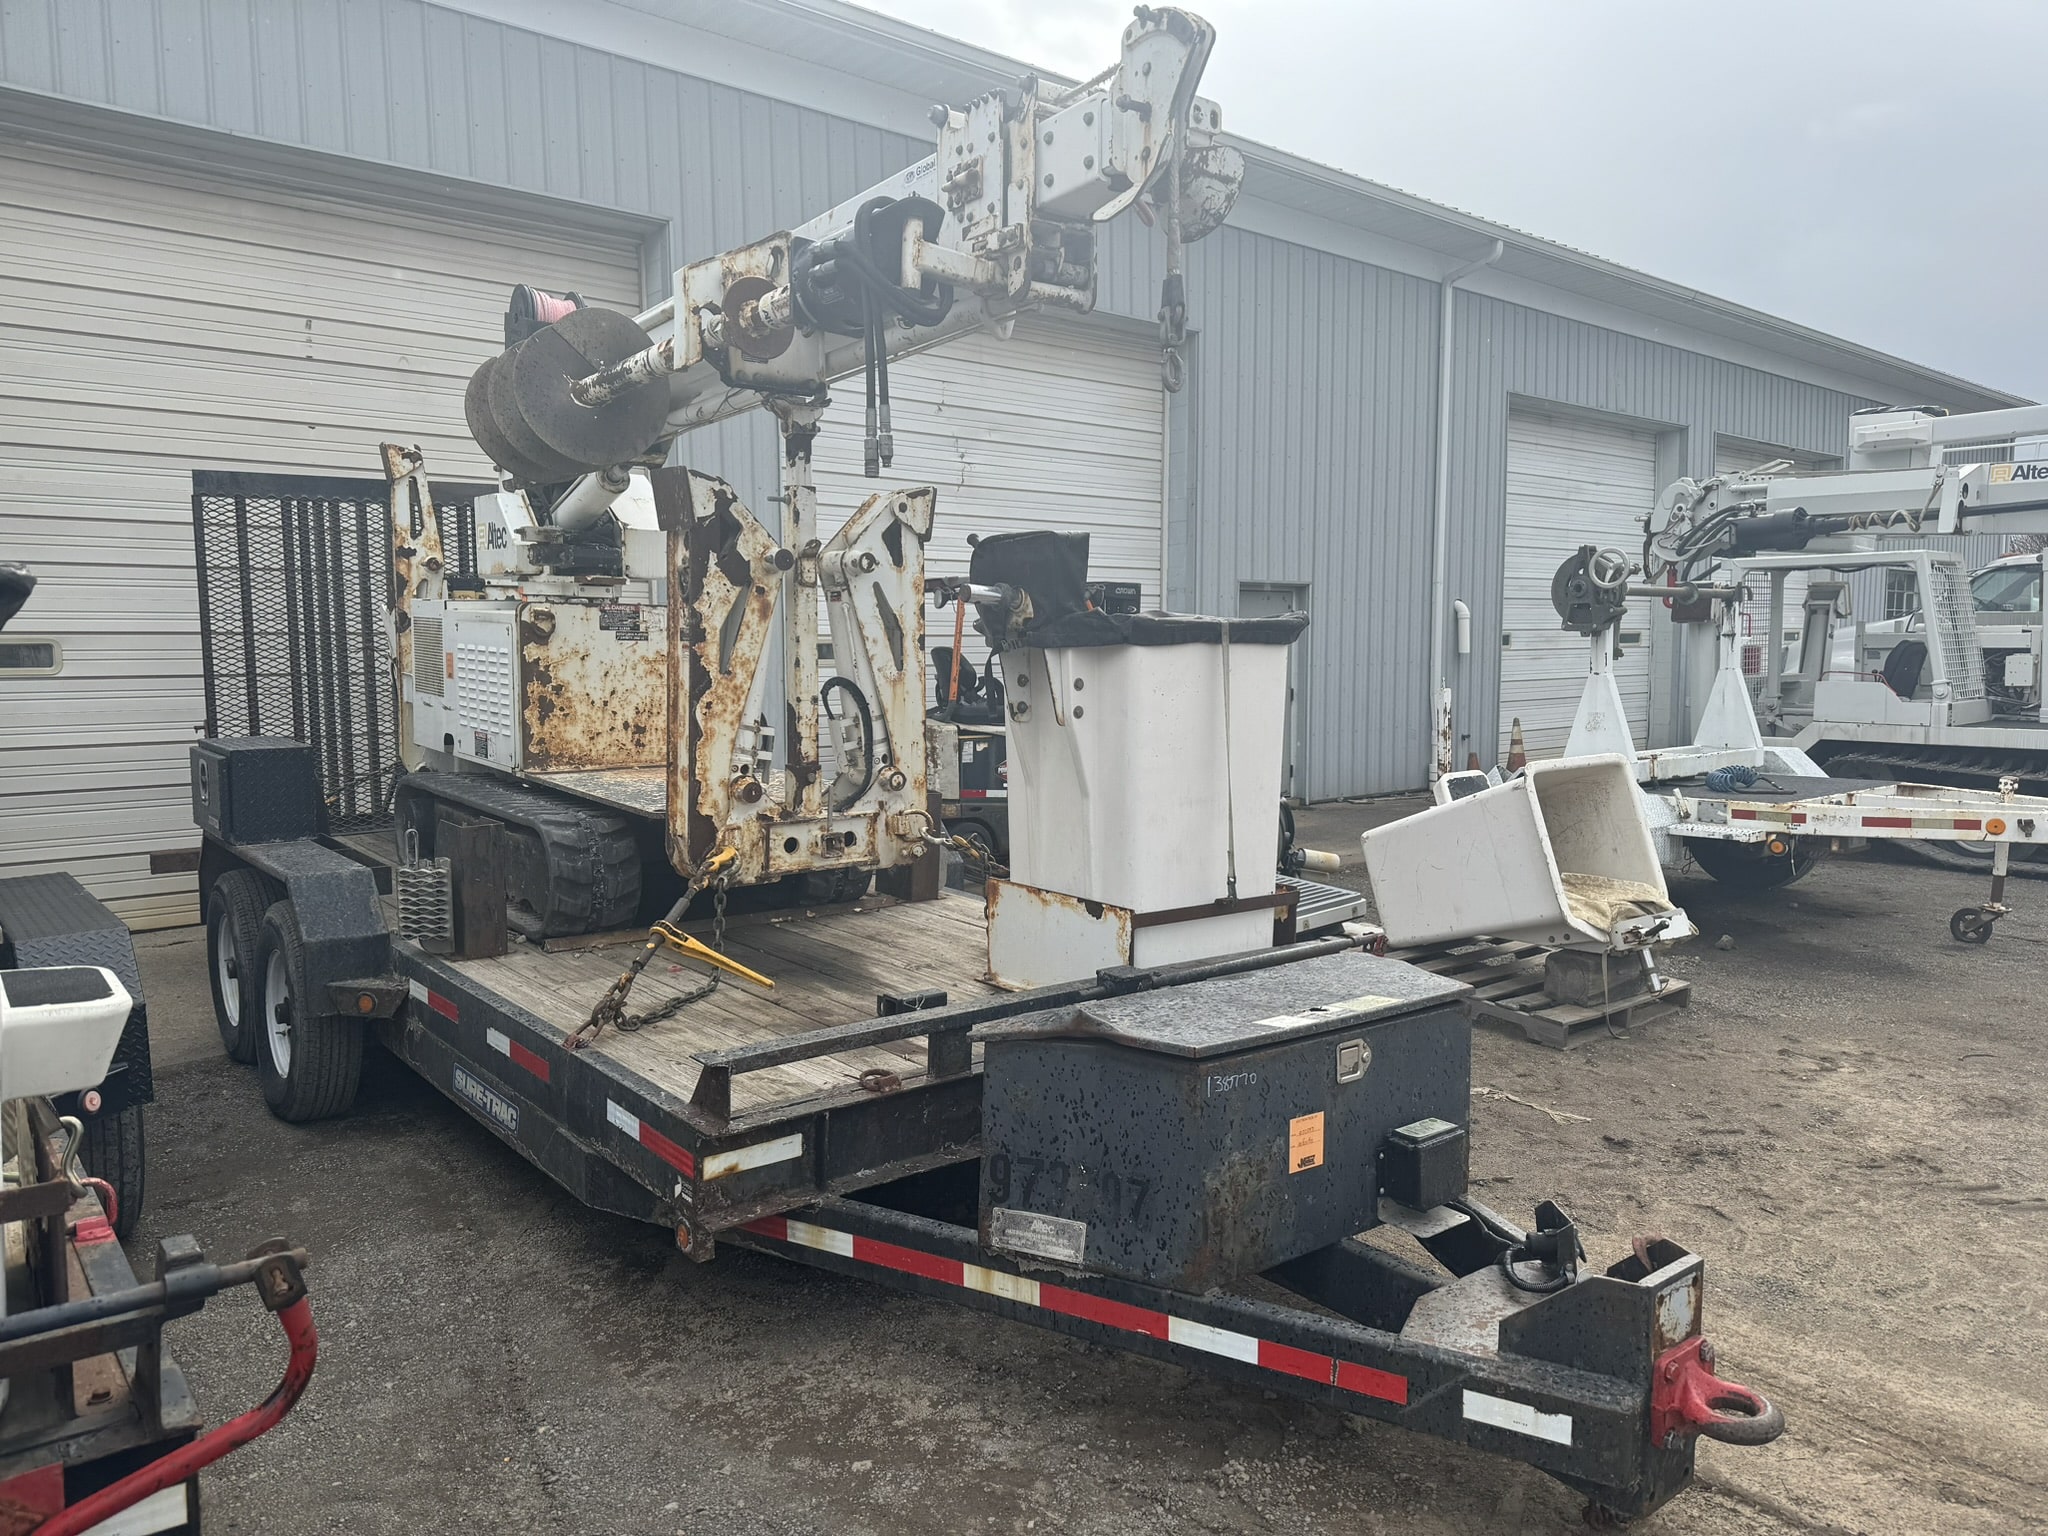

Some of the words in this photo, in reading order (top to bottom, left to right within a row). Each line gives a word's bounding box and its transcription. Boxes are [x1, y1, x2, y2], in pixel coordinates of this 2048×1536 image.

[487, 521, 508, 550] Altec
[454, 1068, 518, 1131] SURE-TRAC
[1030, 1219, 1055, 1234] Altec
